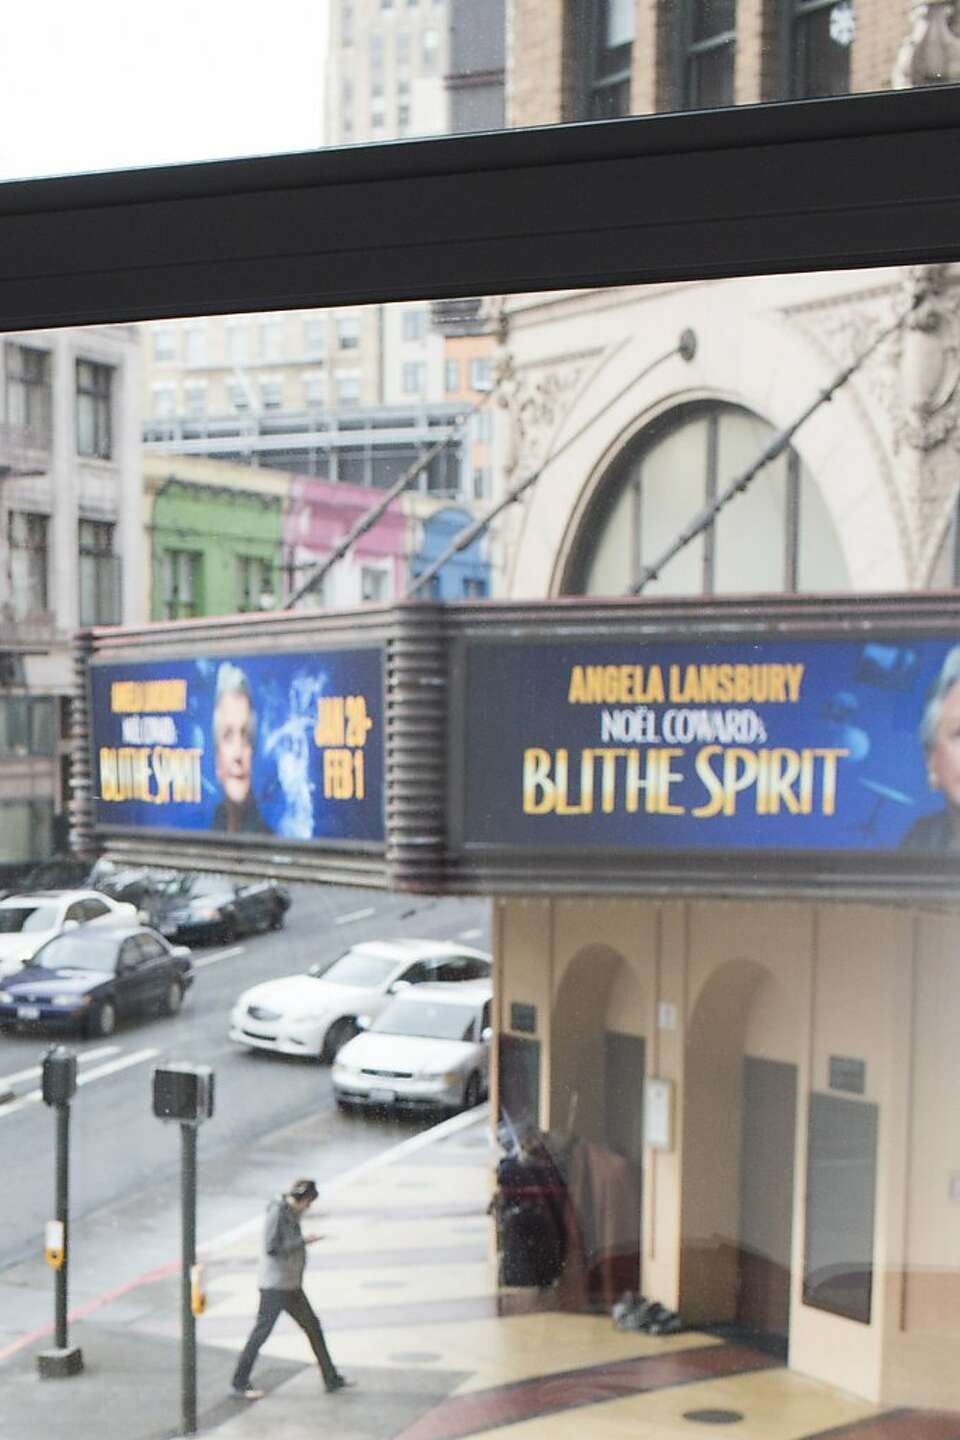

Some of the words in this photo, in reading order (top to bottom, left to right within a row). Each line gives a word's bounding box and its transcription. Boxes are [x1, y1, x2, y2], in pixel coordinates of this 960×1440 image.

[569, 665, 664, 704] ANGELA
[670, 664, 804, 703] LANSBURY
[523, 748, 685, 815] BLITHE
[692, 746, 849, 818] SPIRIT
